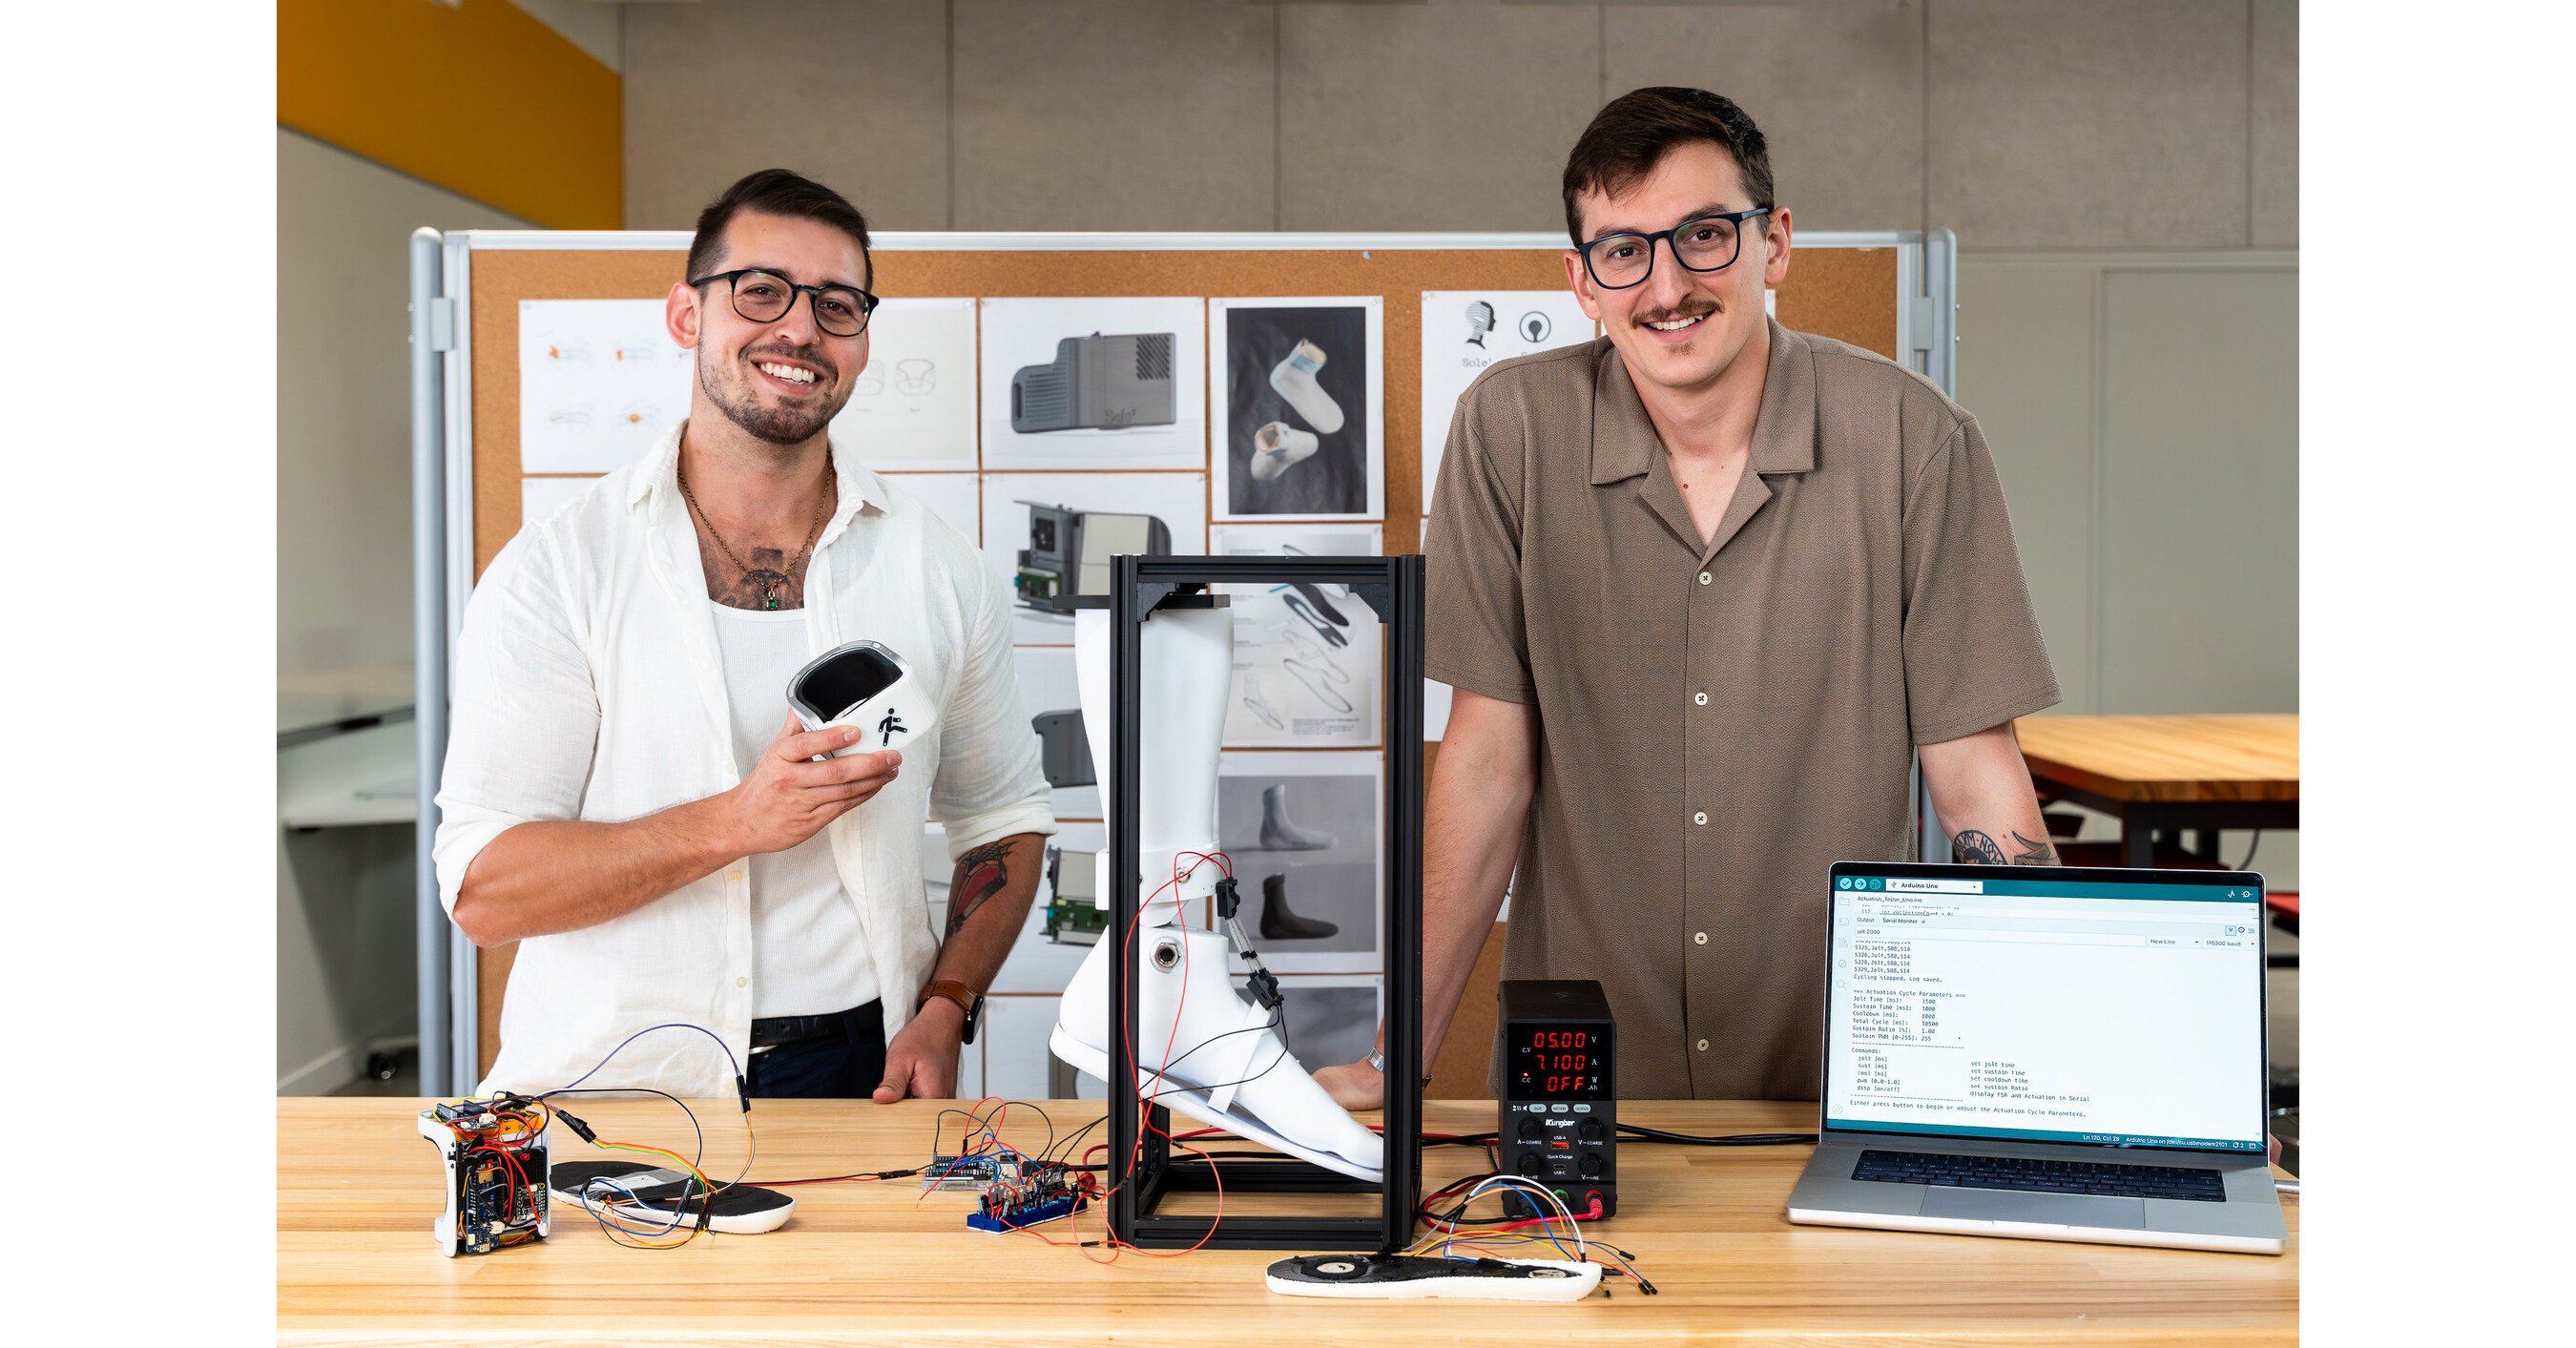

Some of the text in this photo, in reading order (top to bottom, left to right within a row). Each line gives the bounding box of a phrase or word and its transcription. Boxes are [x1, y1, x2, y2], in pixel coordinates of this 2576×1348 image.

[1534, 1032, 1586, 1047] 05.00
[1548, 1076, 1585, 1091] OFF
[1546, 1119, 1575, 1128] Kungber
